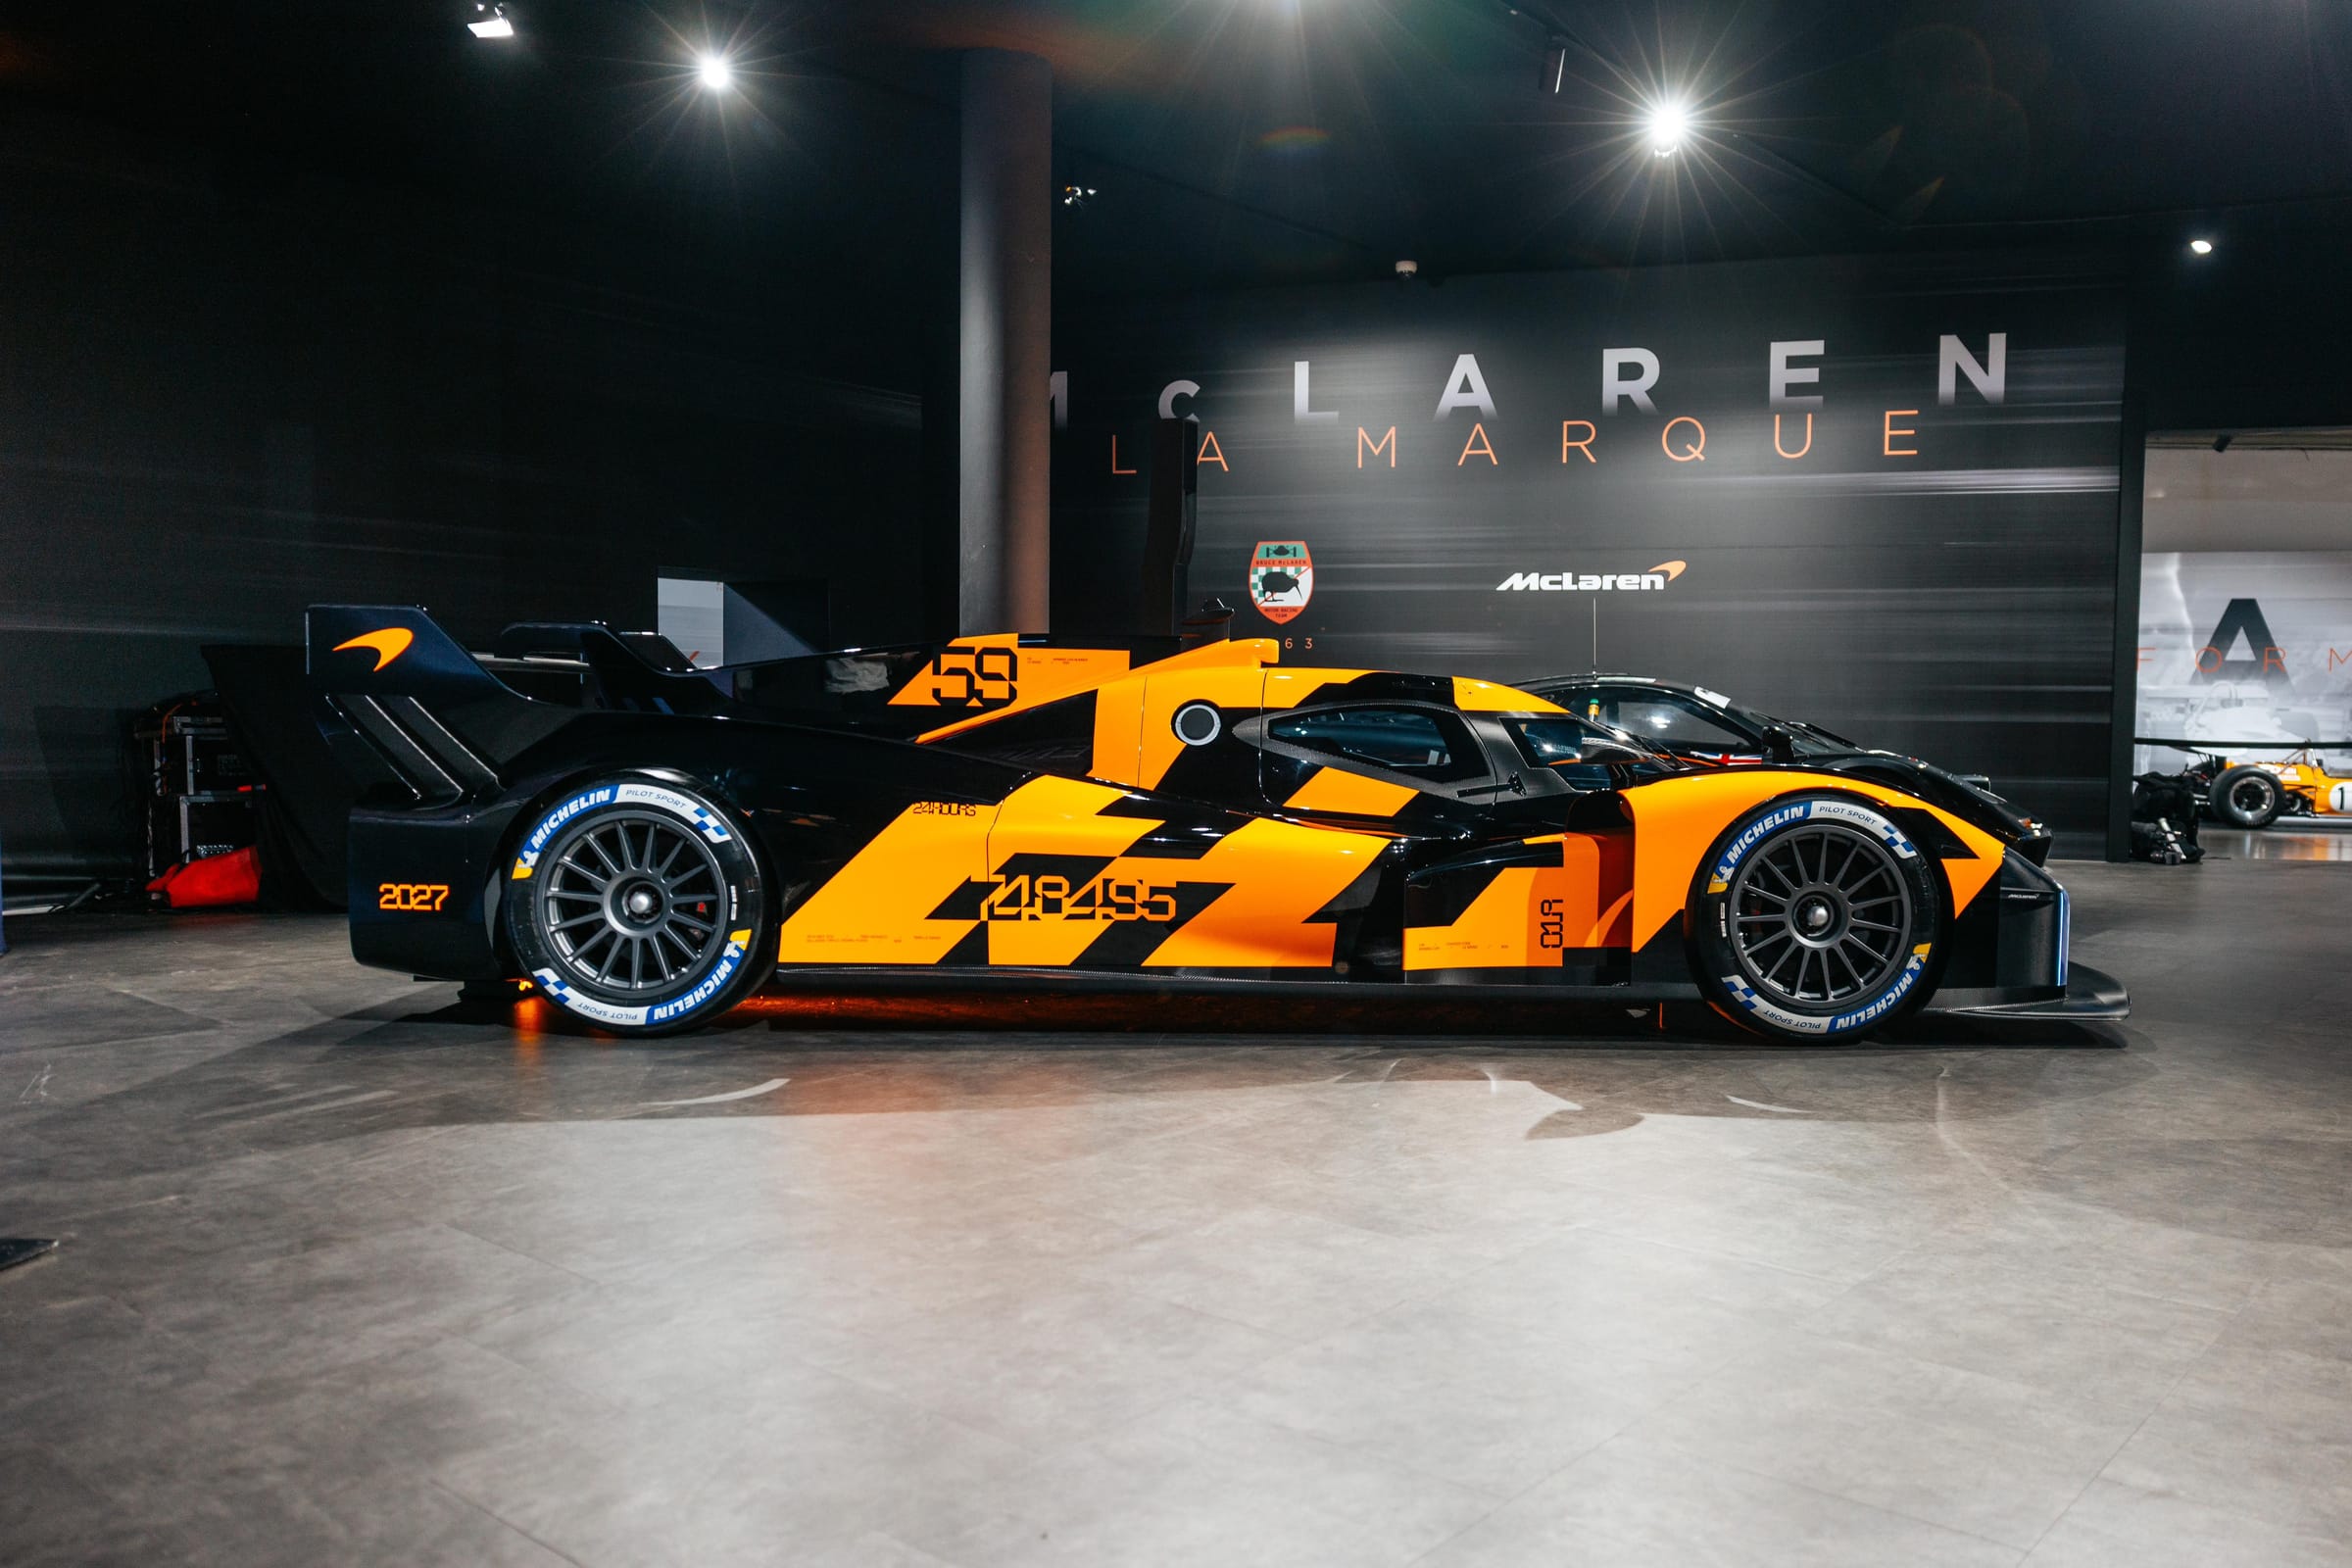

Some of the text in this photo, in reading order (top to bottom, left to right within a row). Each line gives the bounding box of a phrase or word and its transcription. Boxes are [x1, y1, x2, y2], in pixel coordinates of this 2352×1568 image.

[1051, 332, 2007, 434] cLAREN
[1112, 409, 1919, 474] LA MARQUE
[1495, 571, 1665, 591] McLaren
[932, 647, 1017, 707] 59
[531, 788, 686, 850] MICHELIN PILOT SPORT
[1727, 806, 1878, 863] MICHELIN PILOT SPORT
[378, 883, 449, 910] 2027
[577, 959, 733, 1021] MICHELIN PILOT SPORT
[1763, 972, 1913, 1030] MICHELIN PILOT SPORT
